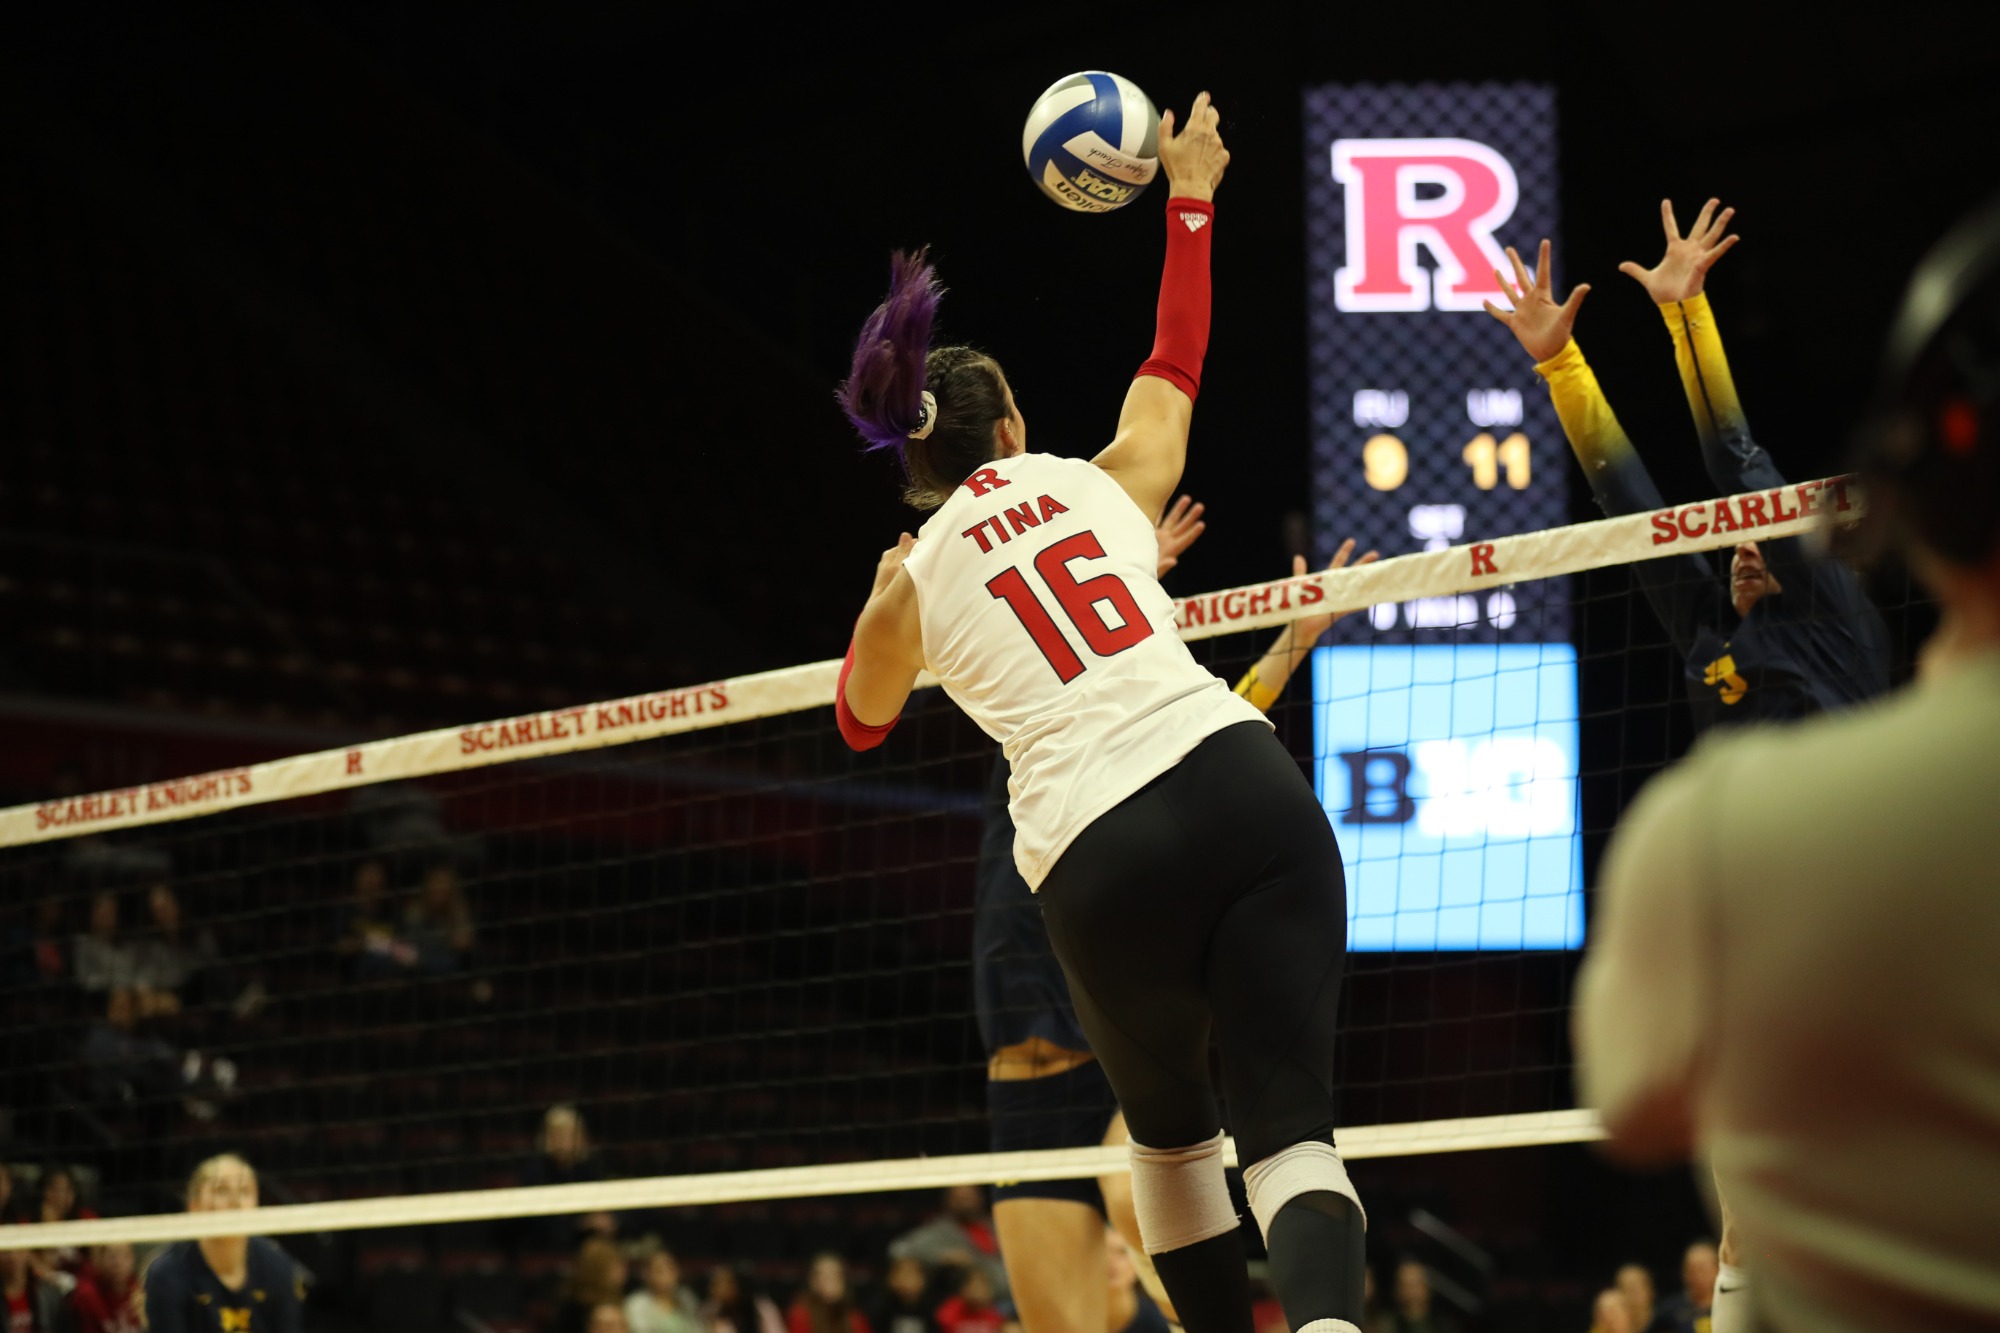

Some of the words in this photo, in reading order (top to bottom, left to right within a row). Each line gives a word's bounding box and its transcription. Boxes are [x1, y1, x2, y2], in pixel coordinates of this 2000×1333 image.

[1073, 168, 1134, 203] NCAA
[1087, 147, 1123, 169] Touch
[1331, 138, 1536, 312] R
[962, 468, 1011, 497] R
[1463, 432, 1530, 491] 11
[961, 494, 1070, 554] TINA
[1471, 544, 1498, 577] R
[985, 530, 1154, 685] 16
[459, 706, 587, 755] SCARLET
[596, 681, 729, 731] KNIGHTS
[345, 748, 363, 775] R
[35, 786, 141, 830] SCARLET
[147, 767, 253, 814] KNIGHTS
